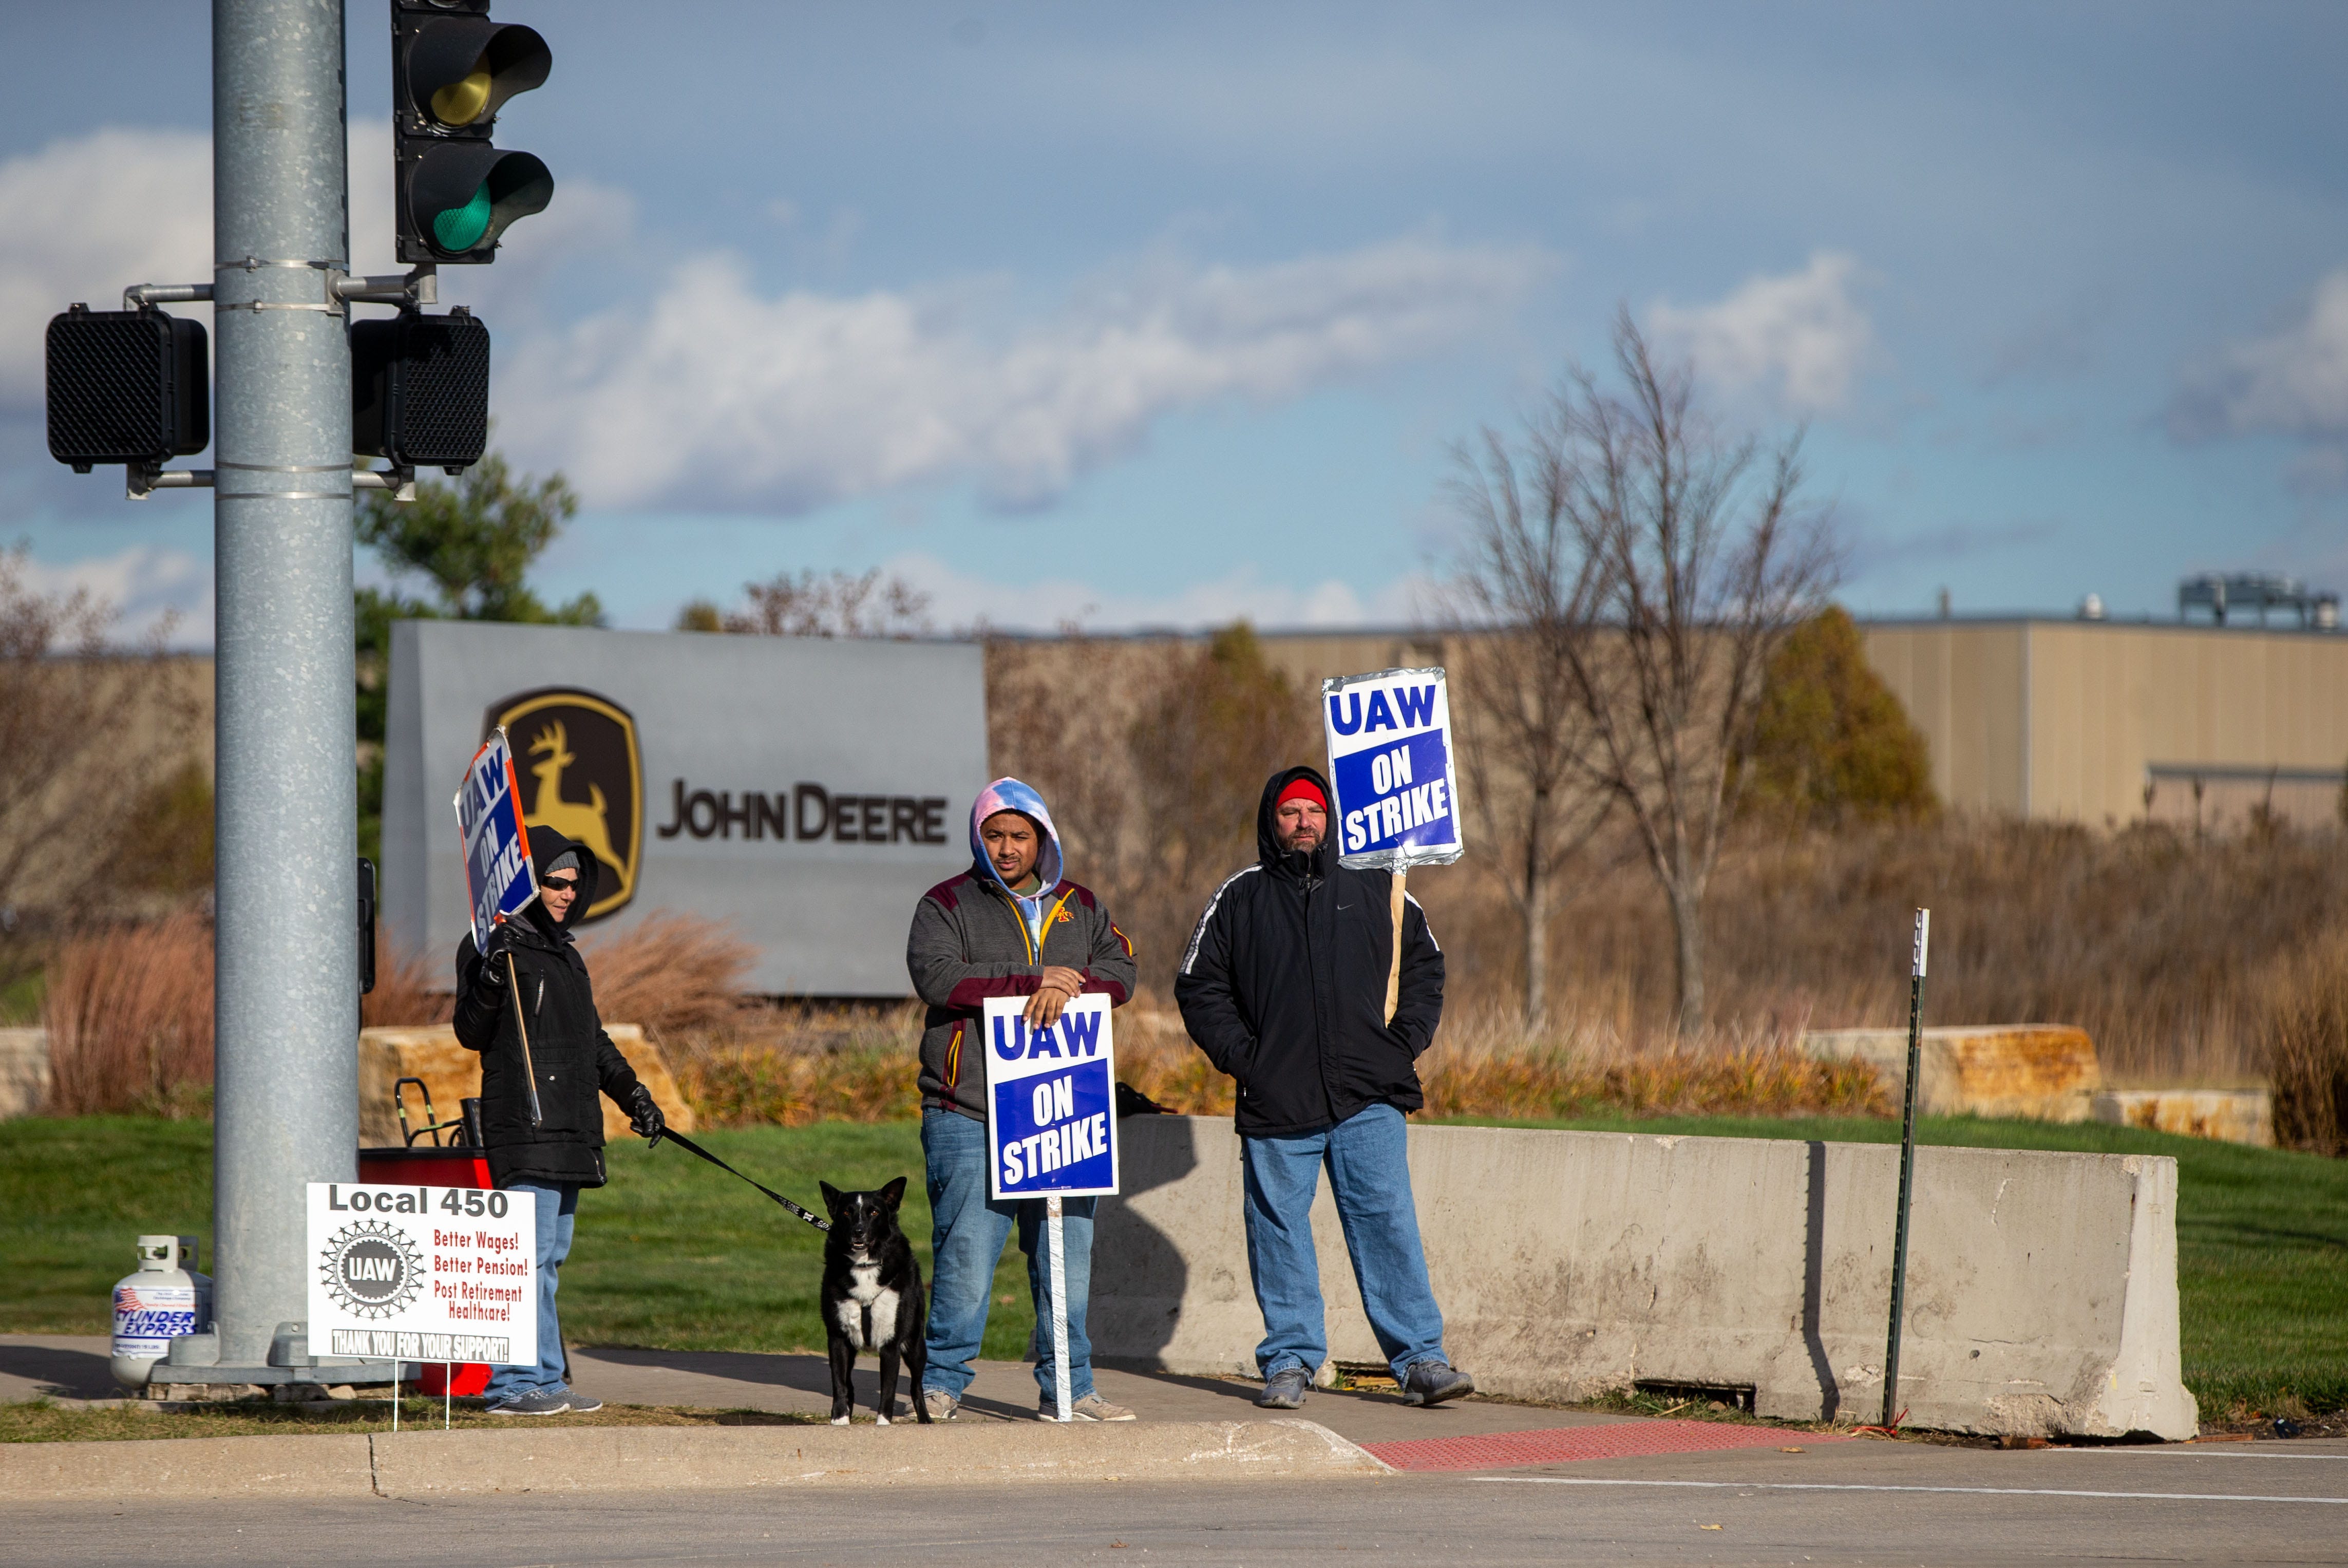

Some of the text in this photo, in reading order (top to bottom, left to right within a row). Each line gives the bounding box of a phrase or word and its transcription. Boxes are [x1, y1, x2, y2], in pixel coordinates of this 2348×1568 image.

[1330, 685, 1436, 735] UAW
[460, 746, 504, 839] UAW
[1371, 744, 1413, 795] ON
[657, 778, 947, 844] JOHN DEERE
[1346, 778, 1449, 851] STRIKE
[480, 818, 500, 878] ON
[477, 832, 523, 944] STRIKE
[993, 1011, 1102, 1061] UAW
[1032, 1075, 1073, 1126] ON
[1003, 1112, 1107, 1185] STRIKE
[330, 1184, 508, 1218] Local 450
[434, 1229, 518, 1254] Better Wages!
[434, 1255, 527, 1276] Better Pension!
[349, 1257, 397, 1281] UAW
[434, 1280, 522, 1301] Post Retirement
[116, 1310, 195, 1323] CYLINDER
[124, 1323, 198, 1335] EXPRESS
[449, 1300, 510, 1321] Healthcare!
[333, 1330, 508, 1362] THANK YOU FOR YOUR SUPPORT!
